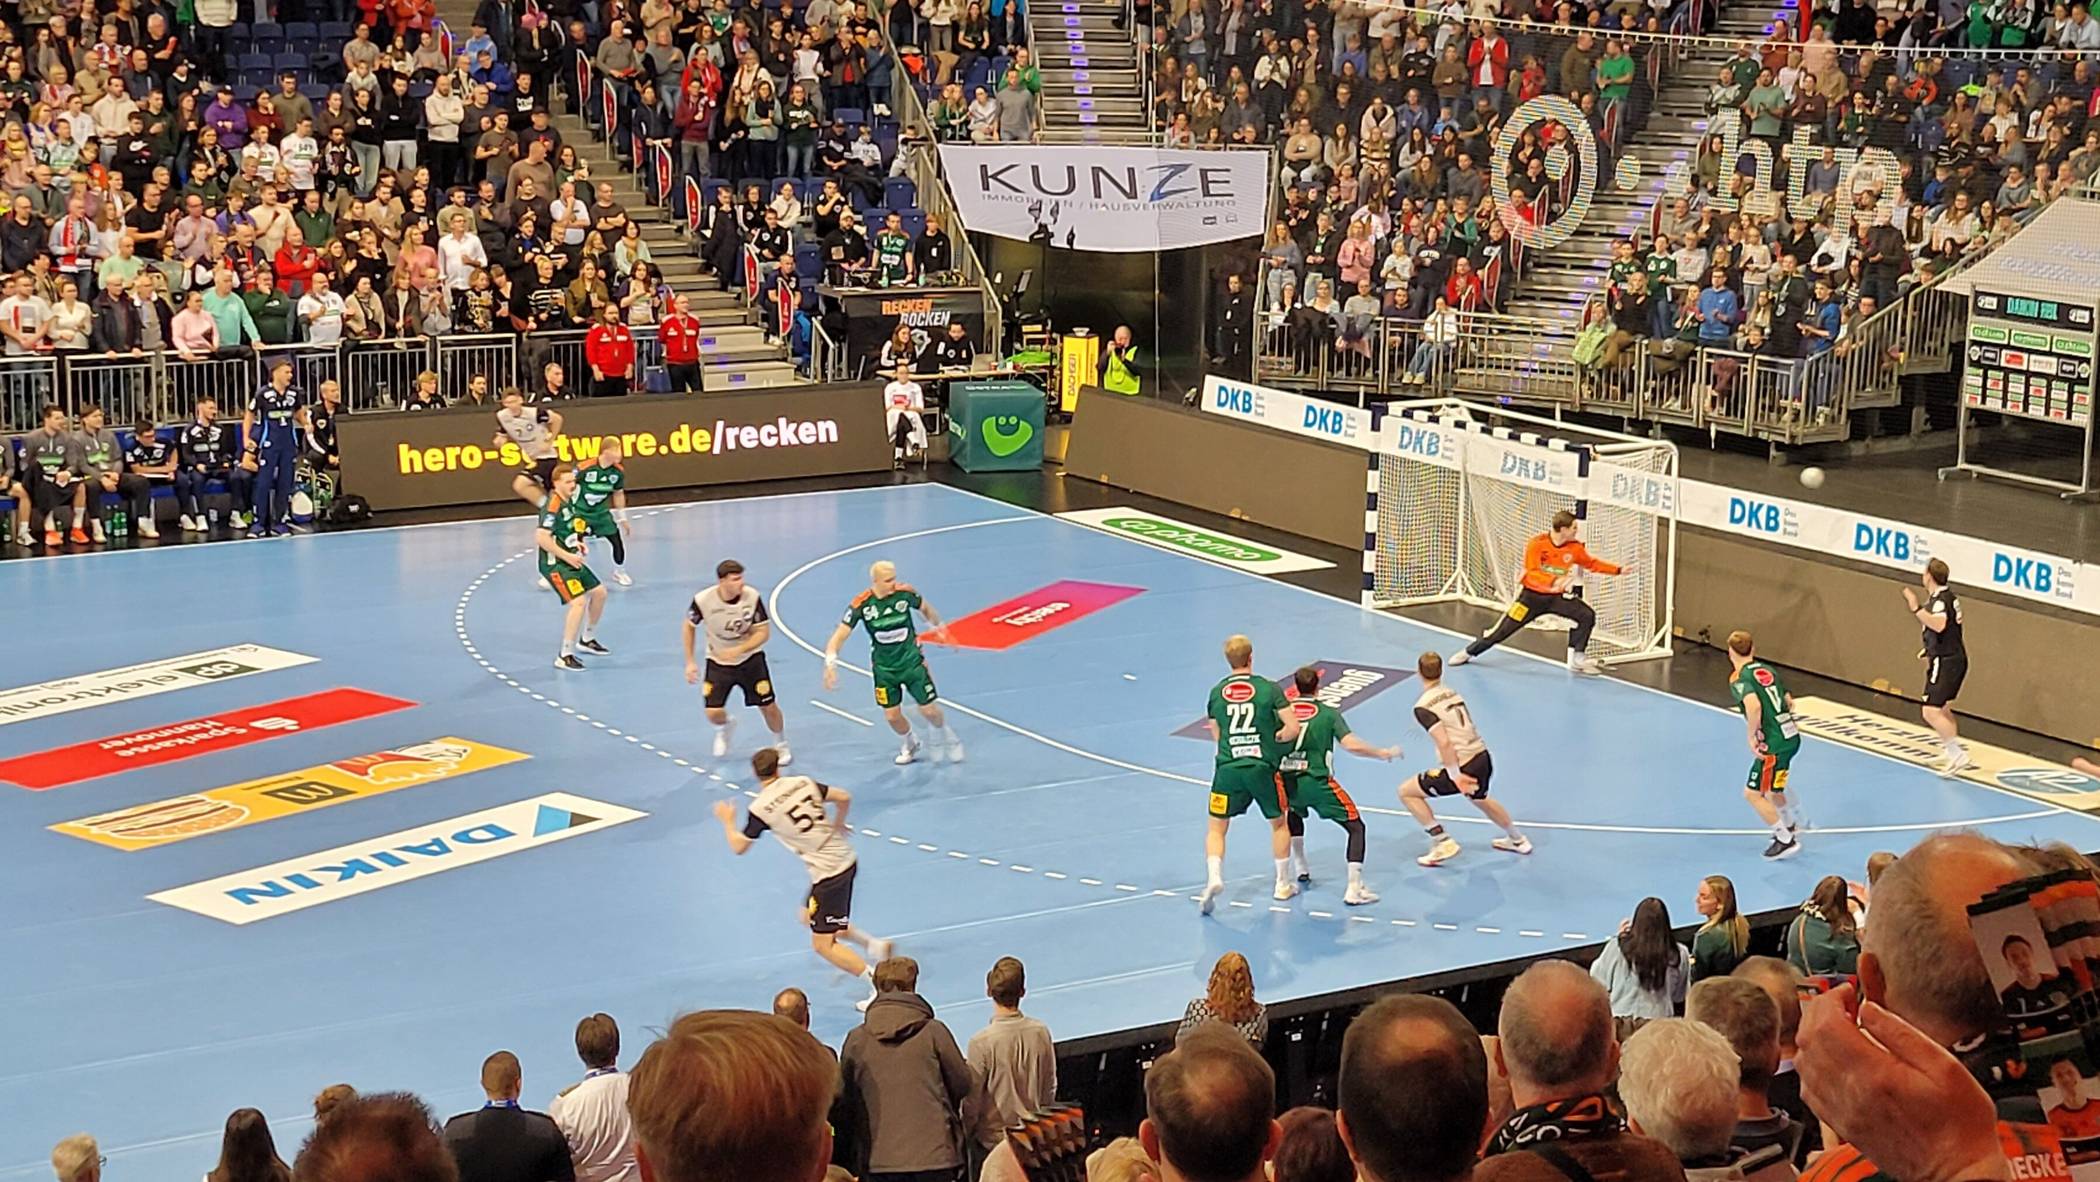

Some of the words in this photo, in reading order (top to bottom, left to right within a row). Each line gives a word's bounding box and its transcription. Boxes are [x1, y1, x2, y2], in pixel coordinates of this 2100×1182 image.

[980, 163, 1235, 202] KUNZE
[1216, 385, 1253, 414] DKB
[1303, 404, 1344, 435] DKB
[1398, 425, 1440, 456] DKB
[1728, 497, 1781, 532] DKB
[1853, 522, 1910, 561] DKB
[1993, 552, 2052, 592] DKB
[99, 719, 224, 750] Hannover
[1226, 703, 1257, 734] 22
[115, 725, 249, 758] Sparkasse
[223, 823, 518, 905] DAIKIN
